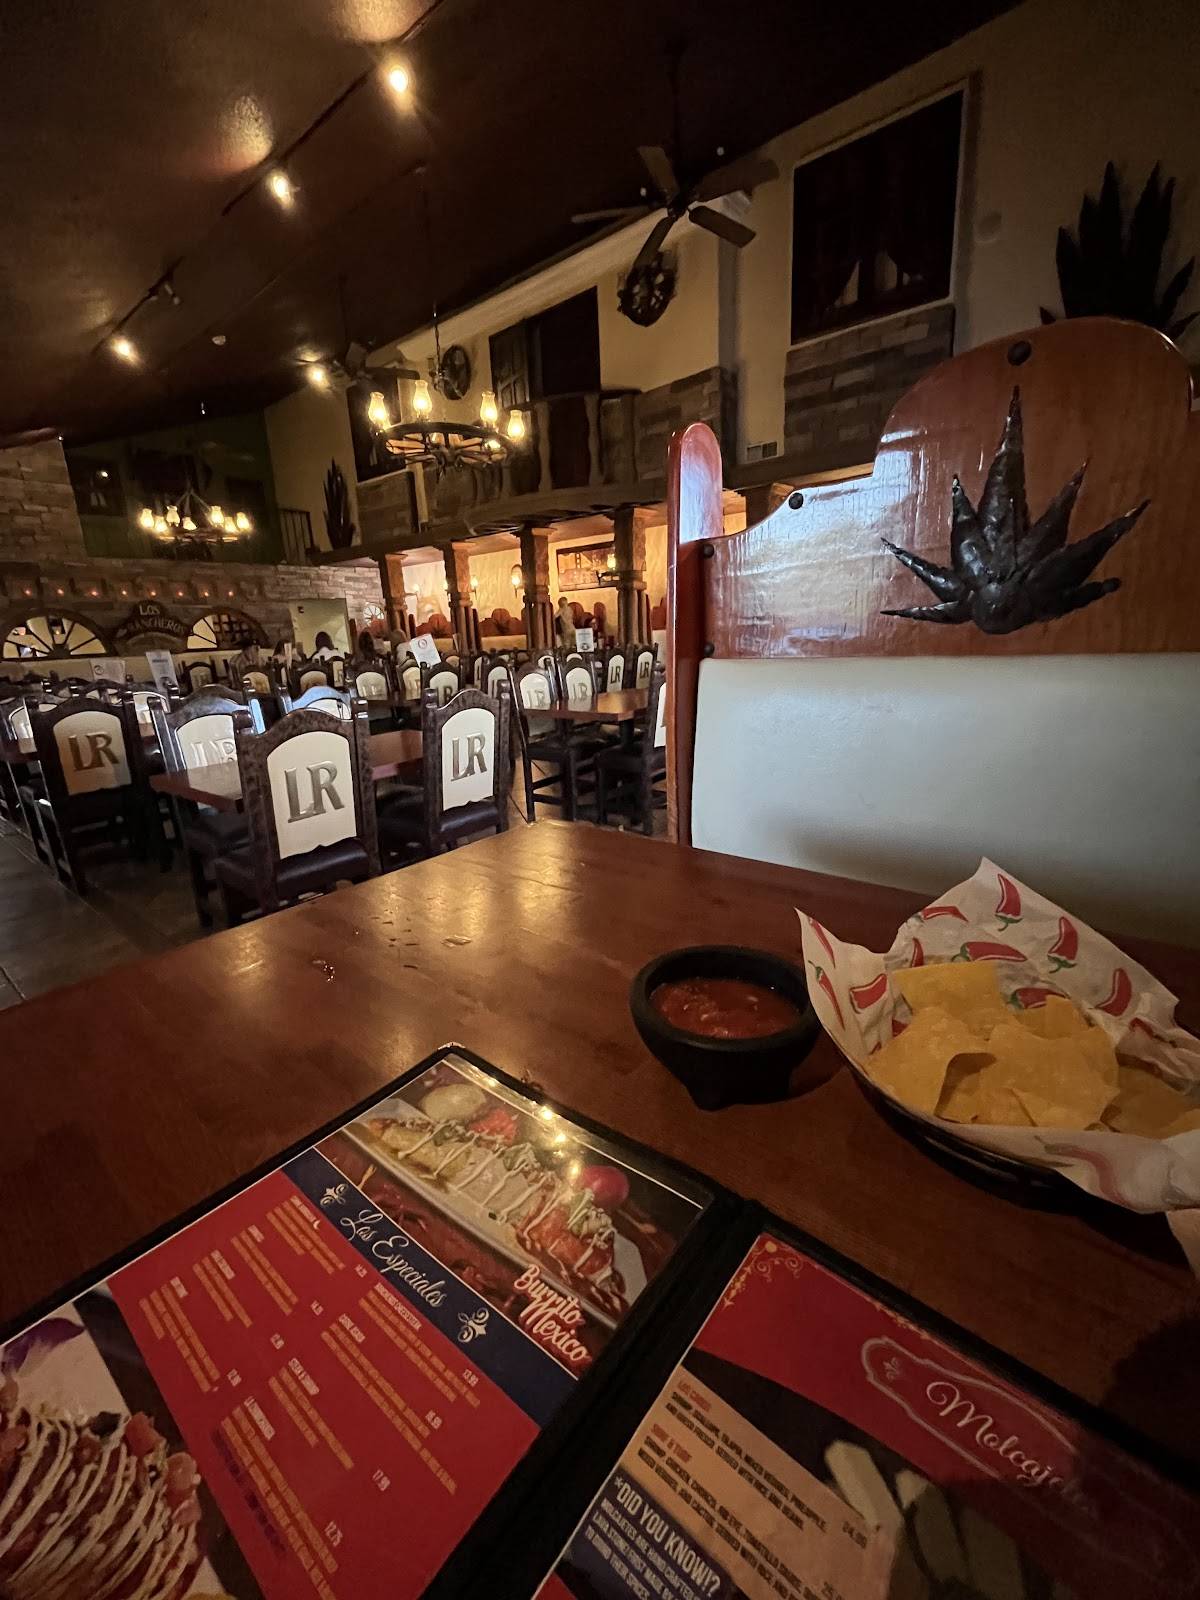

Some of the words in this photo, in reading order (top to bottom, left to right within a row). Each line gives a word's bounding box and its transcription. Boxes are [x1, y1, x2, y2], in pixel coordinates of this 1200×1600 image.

[139, 604, 160, 616] LOS
[610, 666, 622, 684] LR
[67, 731, 120, 772] LR
[451, 732, 488, 782] LR
[284, 760, 345, 824] LR
[372, 1235, 448, 1308] Especiales
[514, 1264, 582, 1324] Burrito
[520, 1299, 590, 1361] Mexico
[639, 1504, 669, 1543] YOU
[664, 1531, 721, 1598] KNOW!?
